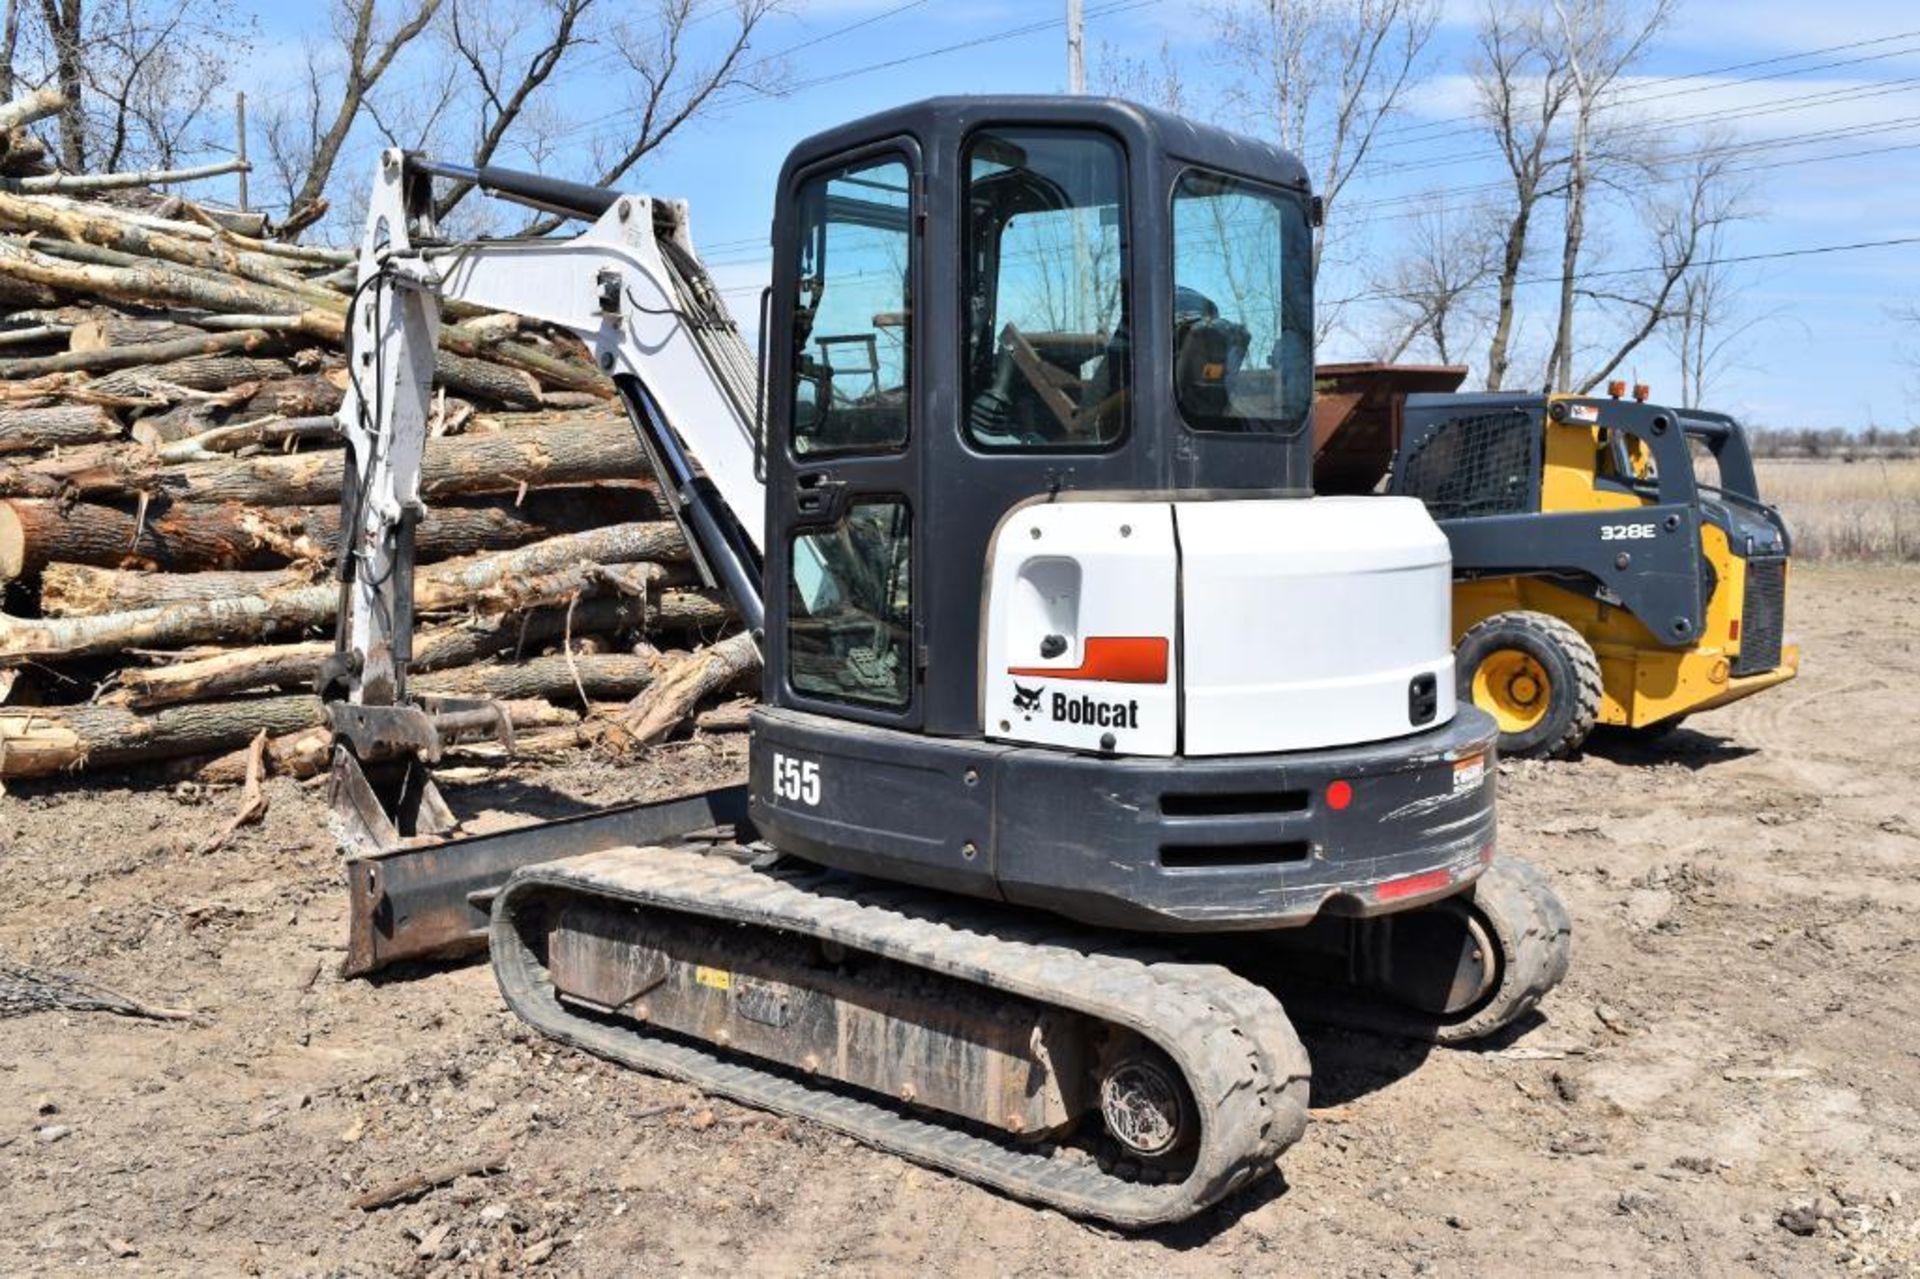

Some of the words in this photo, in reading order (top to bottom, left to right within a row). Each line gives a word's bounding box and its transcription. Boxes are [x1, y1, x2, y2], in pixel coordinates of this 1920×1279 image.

[1600, 523, 1657, 541] 328E
[1051, 691, 1139, 730] Bobcat
[773, 752, 821, 807] E55
